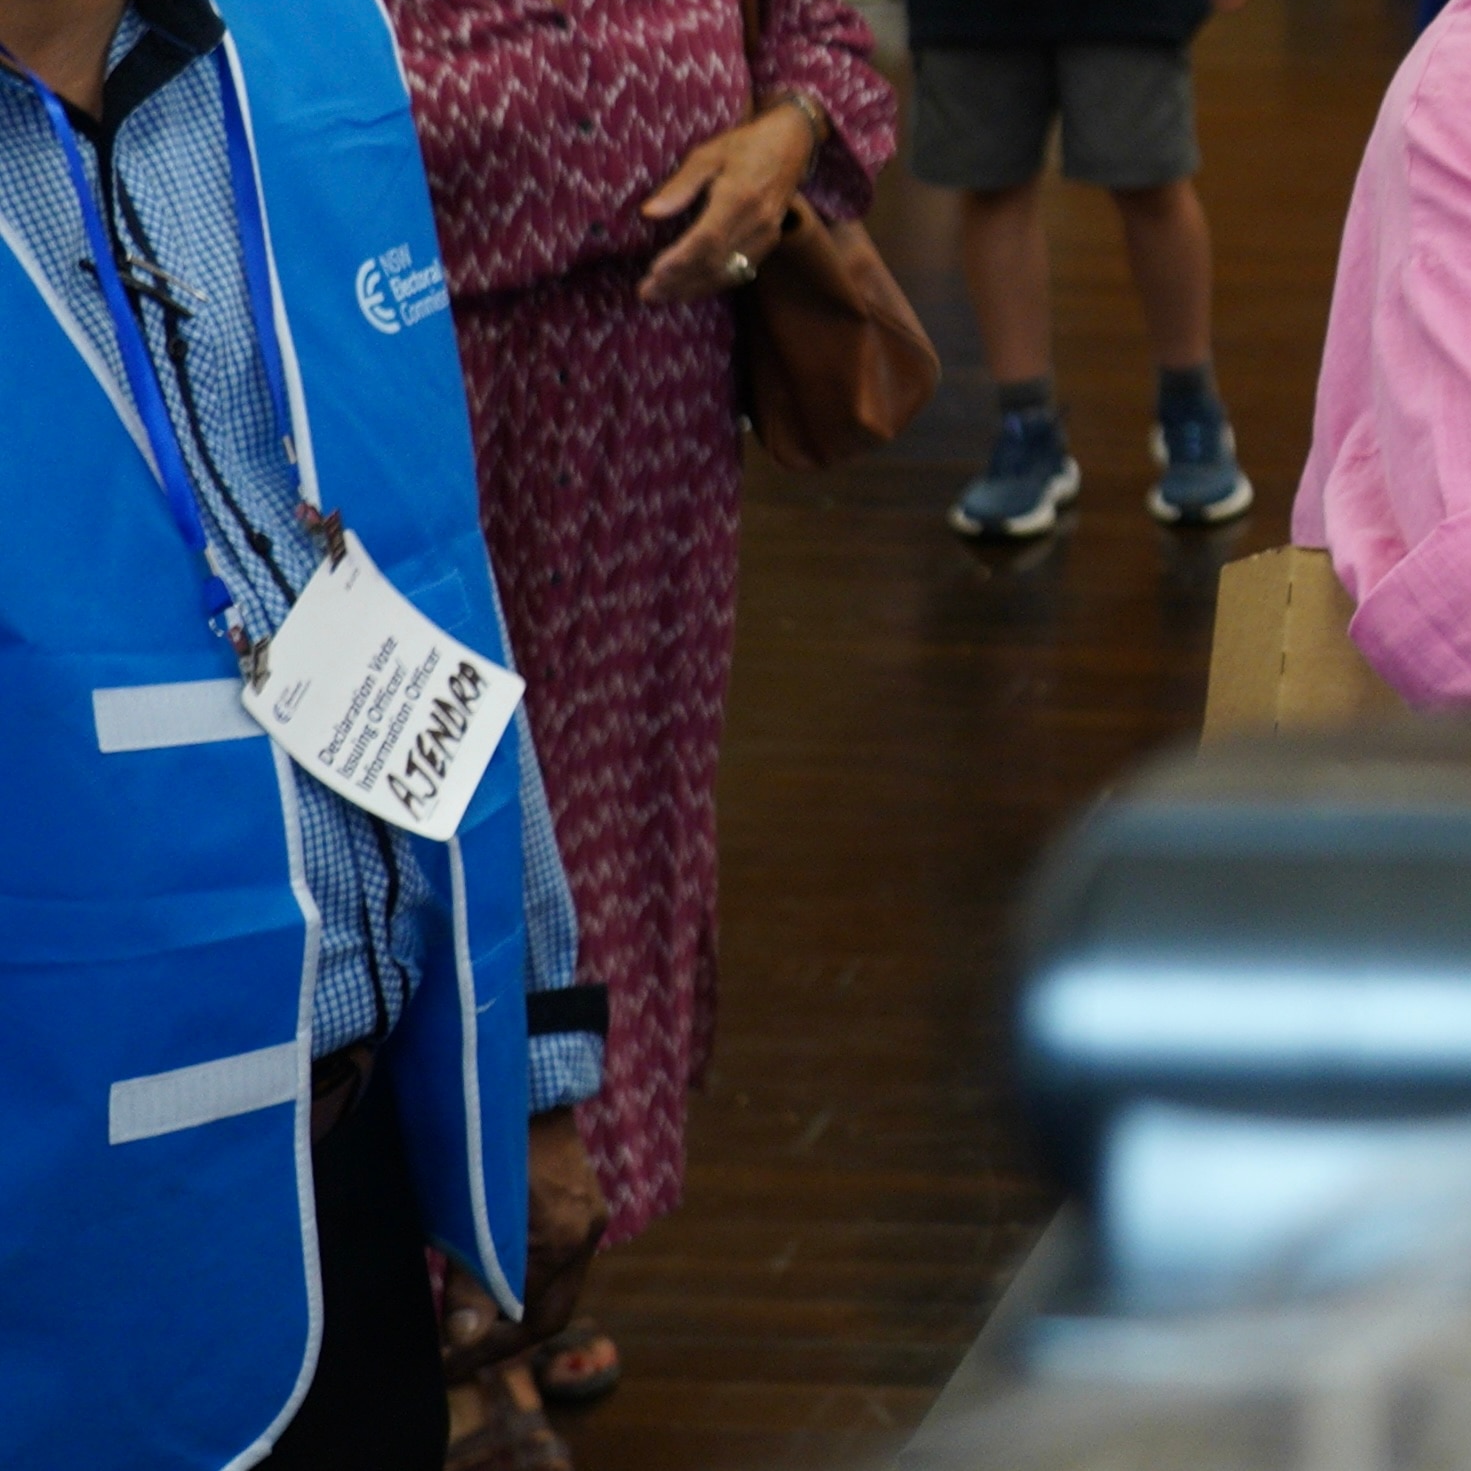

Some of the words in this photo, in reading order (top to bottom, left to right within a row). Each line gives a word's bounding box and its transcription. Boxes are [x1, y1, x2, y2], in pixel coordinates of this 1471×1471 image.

[379, 242, 412, 277] NSW
[389, 257, 443, 302] Electoral
[317, 675, 375, 768] Declaration
[367, 636, 398, 673] Vote
[356, 702, 413, 792] Information
[405, 646, 442, 700] Officer
[387, 661, 487, 820] AJENDRA
[336, 722, 379, 780] Issuing
